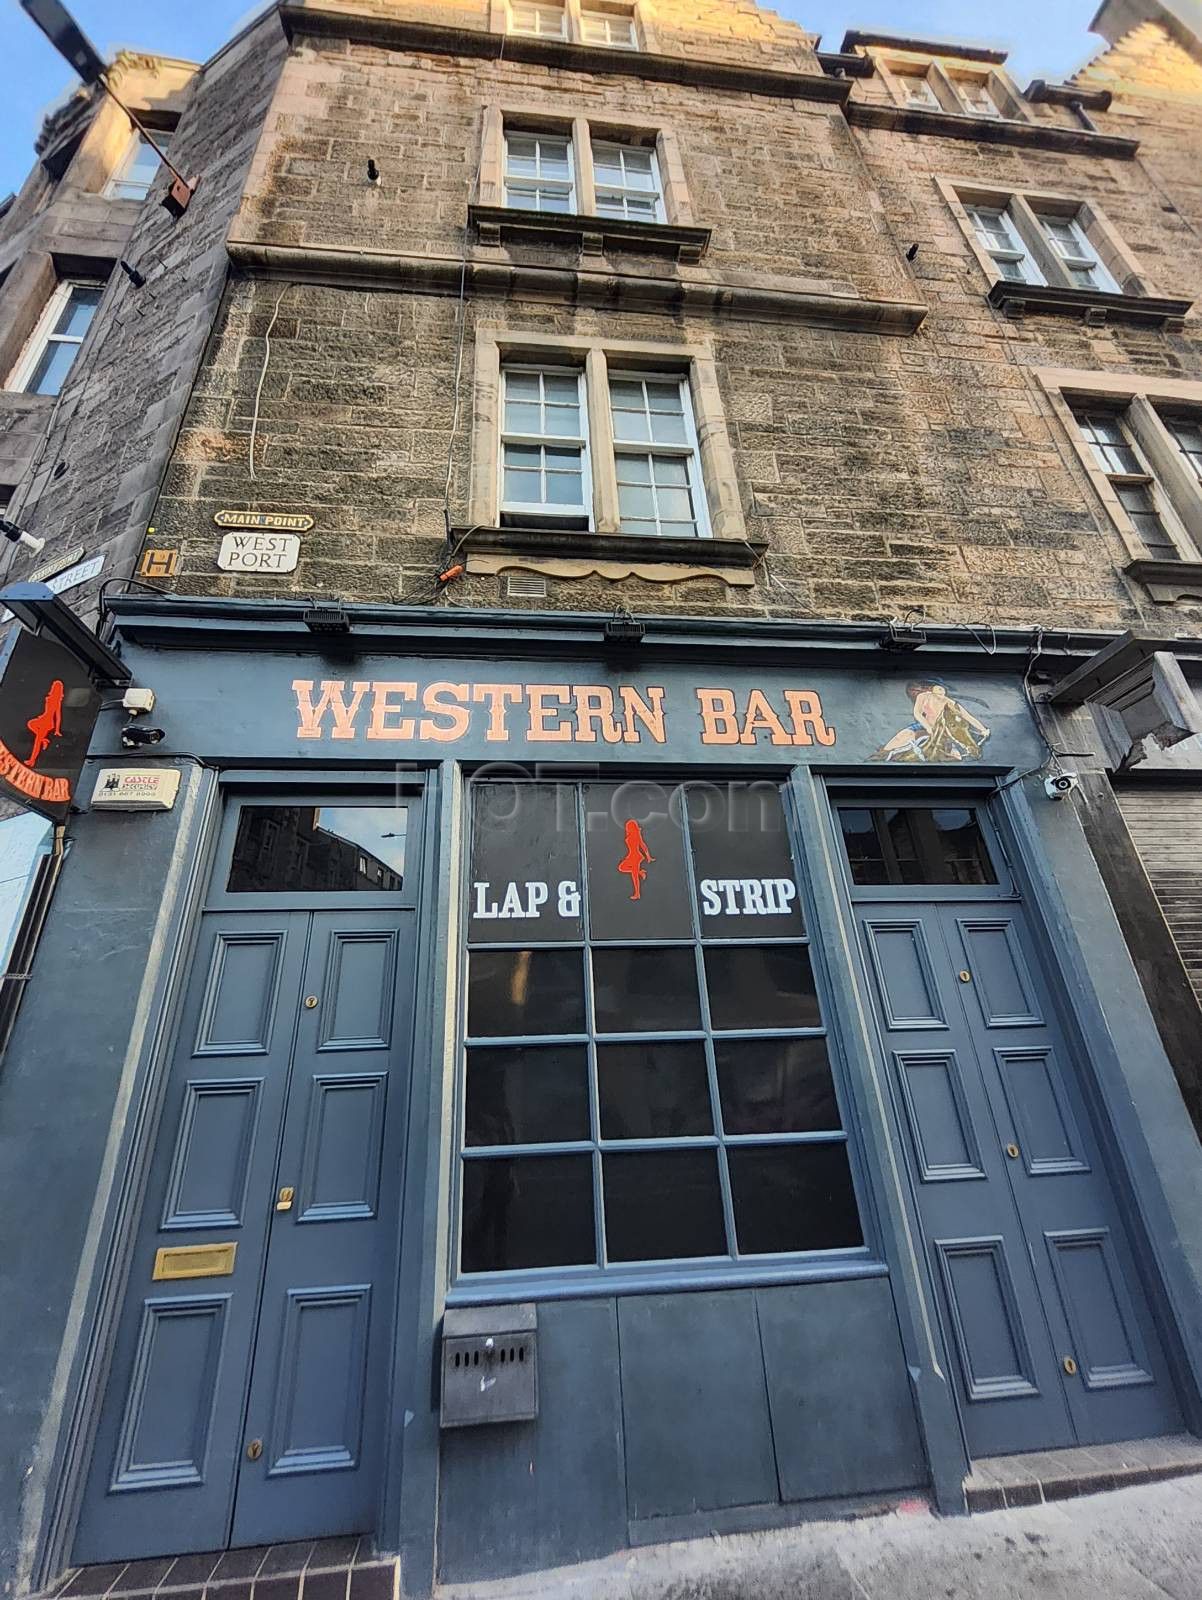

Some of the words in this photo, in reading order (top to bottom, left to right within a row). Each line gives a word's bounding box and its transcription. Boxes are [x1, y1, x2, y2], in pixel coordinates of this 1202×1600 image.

[223, 513, 260, 525] MAIN
[264, 515, 306, 528] POINT
[233, 535, 293, 552] WEST
[146, 552, 174, 574] H
[227, 551, 288, 569] PORT
[291, 679, 667, 743] WESTERN
[695, 686, 837, 747] BAR
[41, 775, 71, 802] BAR
[473, 881, 549, 919] LAP
[557, 880, 582, 918] &
[700, 878, 797, 916] STRIP
